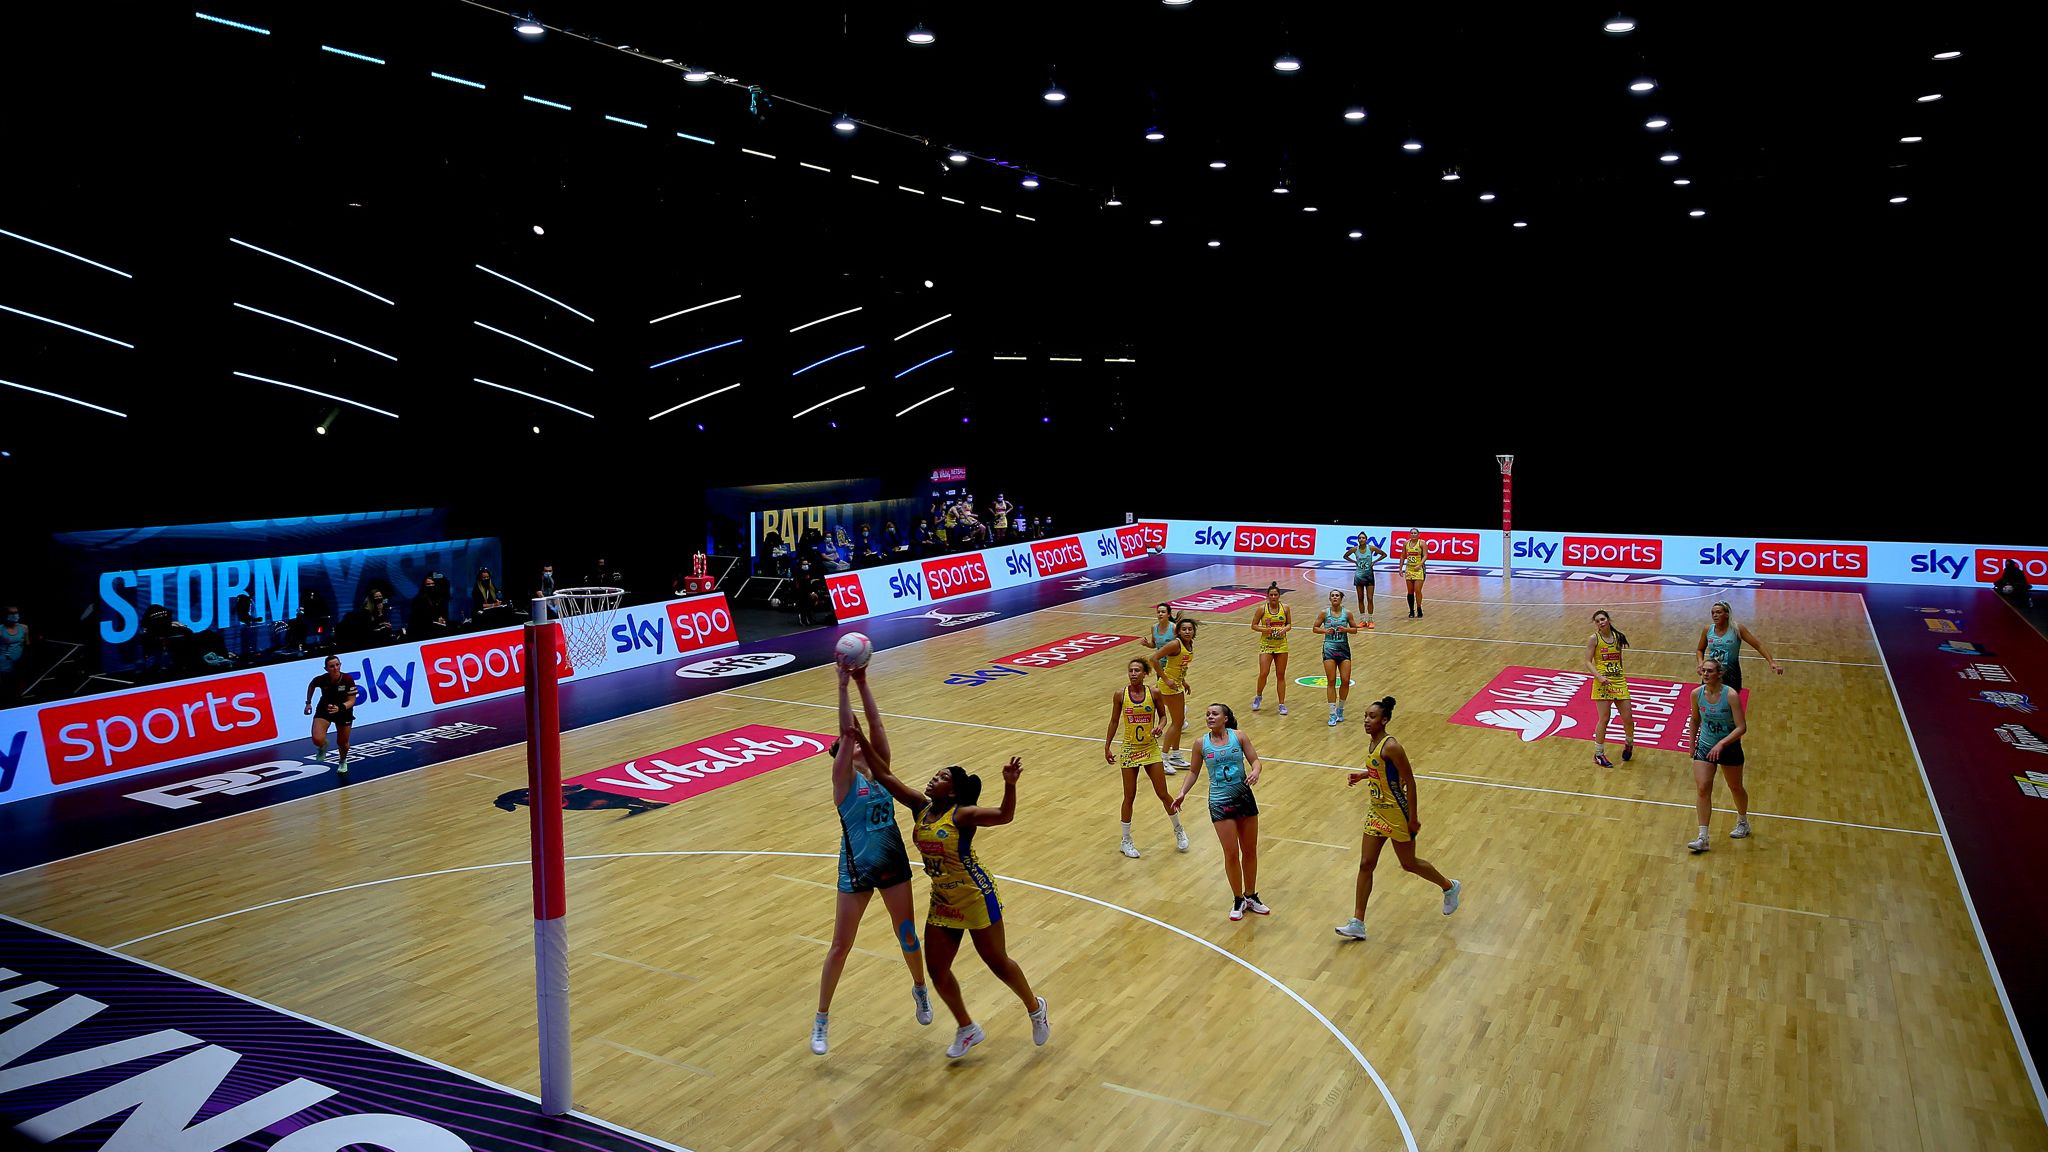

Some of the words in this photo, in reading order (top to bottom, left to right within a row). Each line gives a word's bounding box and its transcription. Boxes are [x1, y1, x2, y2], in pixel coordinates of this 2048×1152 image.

[763, 506, 824, 552] BATH
[1097, 534, 1118, 559] sky
[1120, 526, 1163, 554] spots
[1194, 526, 1232, 550] sky
[1239, 532, 1311, 550] sports
[1346, 535, 1387, 556] sy
[1395, 537, 1474, 555] sorts
[1004, 549, 1032, 578] sky
[1035, 544, 1083, 573] sports
[1513, 537, 1559, 564] sky
[1568, 544, 1656, 565] sports
[1699, 543, 1750, 571] sky
[1761, 550, 1861, 572] sports
[1910, 549, 1969, 579] sky
[889, 568, 922, 601] sky
[928, 561, 986, 594] sports
[99, 556, 299, 644] STORM
[611, 613, 664, 655] sky
[676, 608, 730, 644] spo
[434, 643, 562, 693] spor
[943, 665, 1029, 687] sky
[1012, 634, 1121, 666] sports
[1488, 672, 1595, 708] Vitality
[58, 692, 262, 767] sports
[1135, 725, 1145, 742] C
[595, 734, 825, 791] Vitality
[1223, 766, 1233, 782] C
[870, 802, 890, 825] GS
